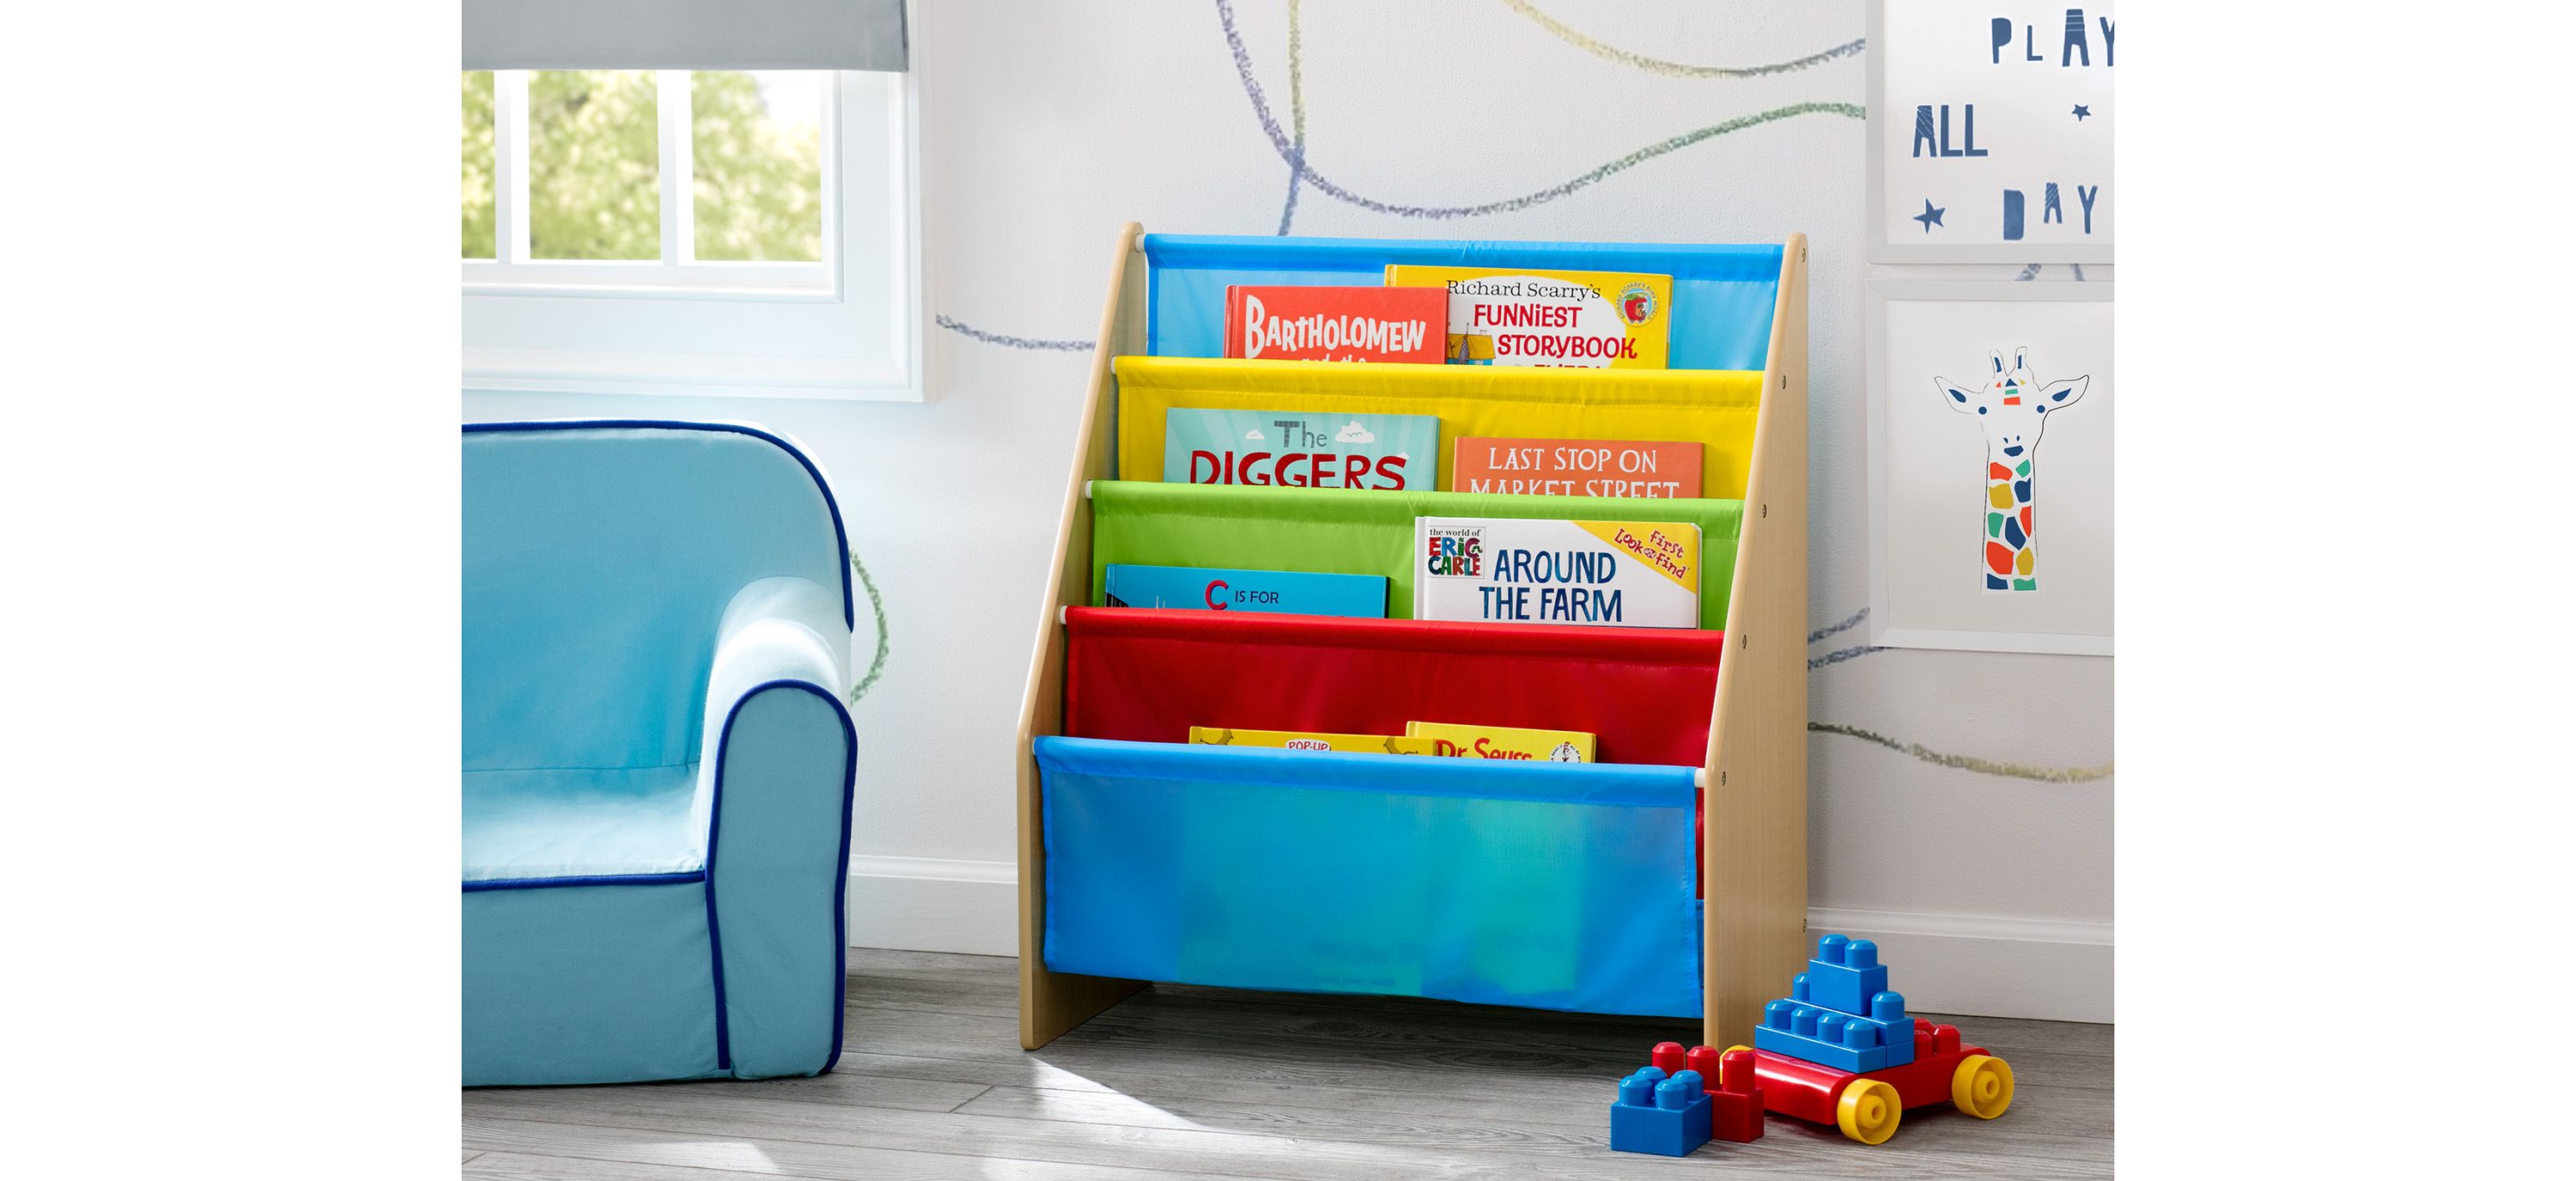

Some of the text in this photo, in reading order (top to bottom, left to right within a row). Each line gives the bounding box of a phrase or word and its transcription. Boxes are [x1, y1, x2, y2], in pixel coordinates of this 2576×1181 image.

[1991, 9, 2114, 67] PLAY
[1913, 104, 1989, 158] ALL
[2003, 182, 2098, 240] DAY
[1447, 280, 1601, 301] Richard Scarry's
[1246, 294, 1426, 359] BARTHOLOMEW
[1498, 334, 1637, 359] STORYBOOK
[1273, 420, 1327, 448] The
[1190, 450, 1407, 491] DIGGERS
[1489, 447, 1656, 473] LAST STOP ON
[1430, 527, 1443, 536] the
[1446, 528, 1470, 537] world
[1428, 556, 1481, 576] CARLE
[1493, 549, 1617, 584] AROUND
[1614, 528, 1643, 554] Look
[1656, 552, 1687, 579] Find
[1205, 580, 1279, 611] C IS FOR
[1479, 586, 1622, 622] THE FARM
[1289, 741, 1328, 751] POP-UP
